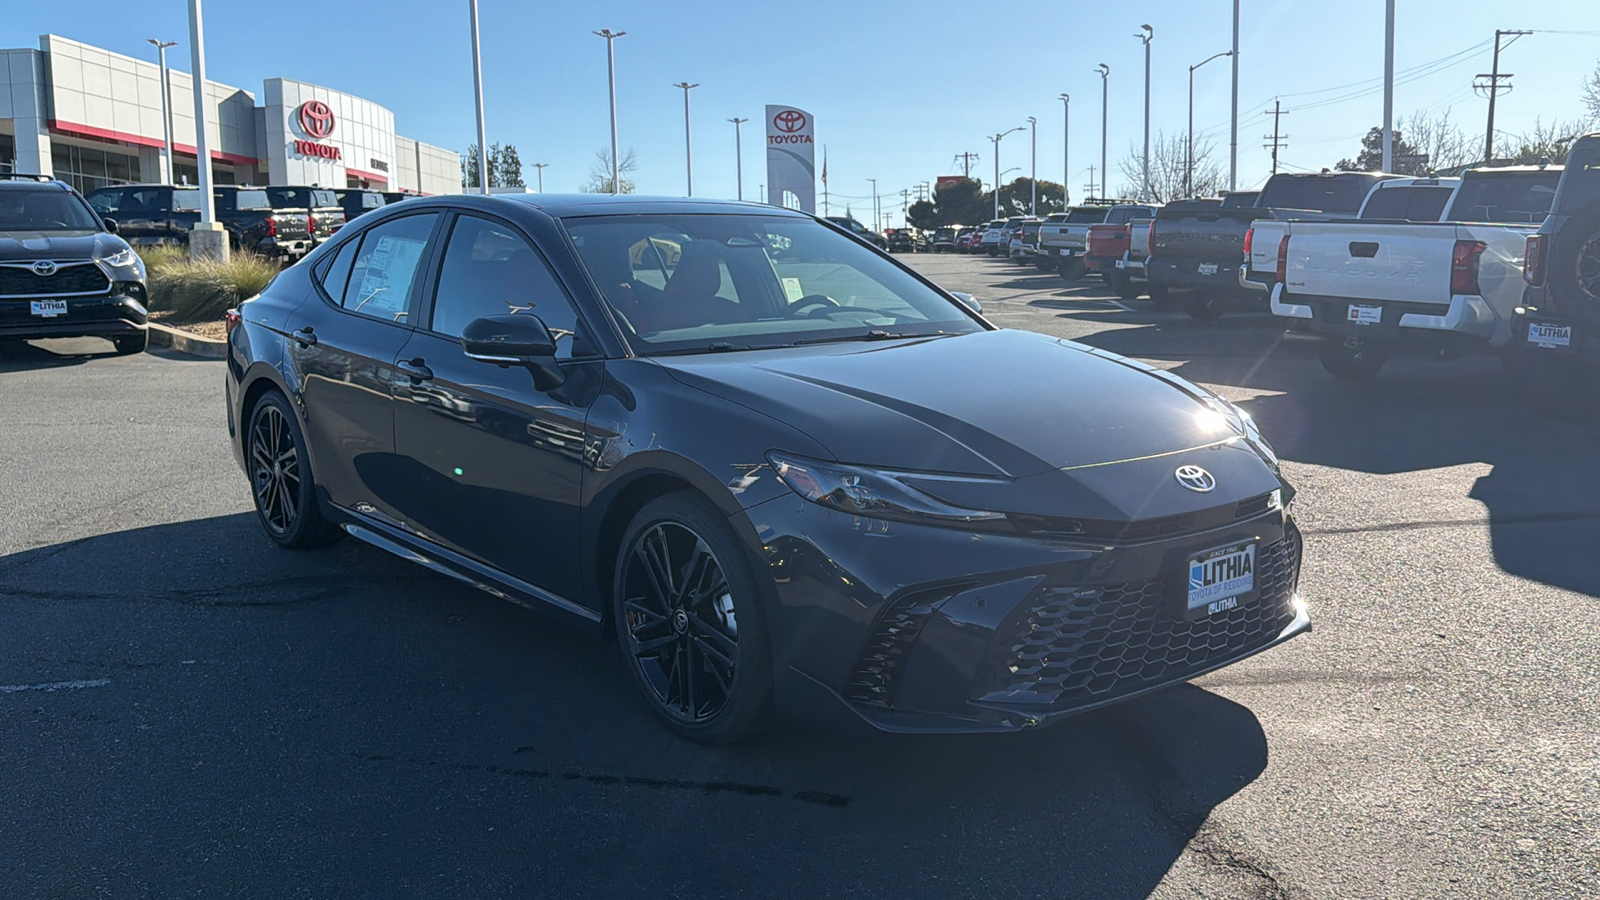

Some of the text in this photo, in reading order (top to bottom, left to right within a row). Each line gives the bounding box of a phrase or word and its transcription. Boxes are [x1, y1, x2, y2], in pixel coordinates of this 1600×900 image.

[768, 135, 812, 144] TOYOTA
[294, 140, 342, 160] TOYOTA
[40, 302, 66, 310] LITHIA
[1538, 327, 1569, 339] LITHIA
[1203, 552, 1252, 587] LITHIA
[1189, 575, 1252, 602] TOYOTA OF REDDING
[1214, 596, 1238, 612] LITHIA
